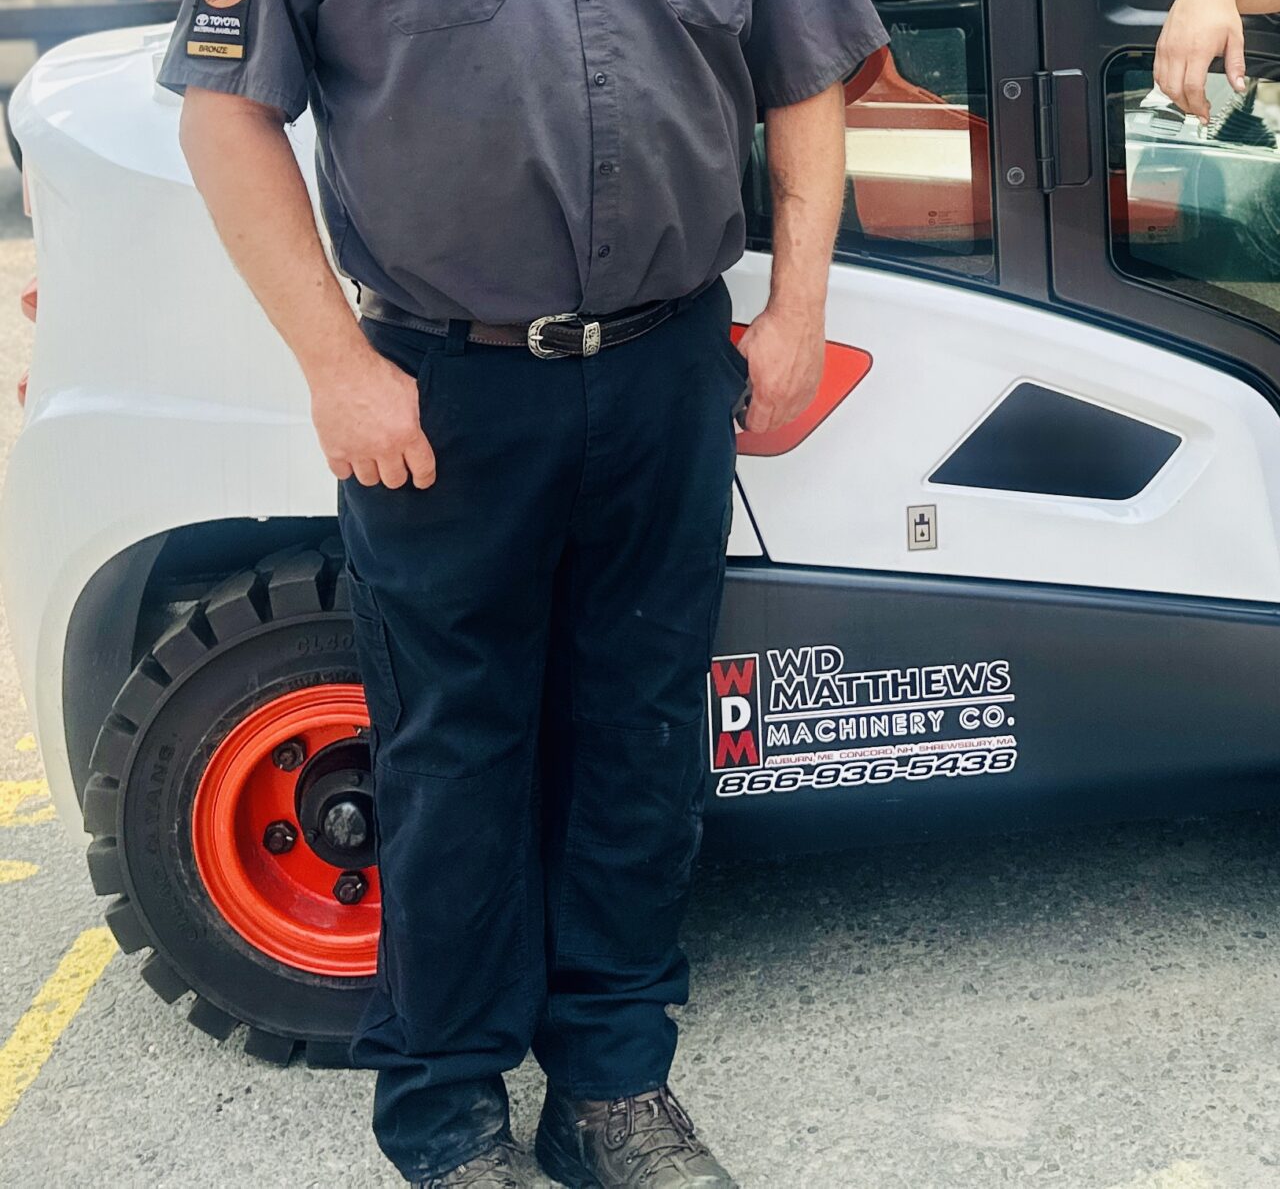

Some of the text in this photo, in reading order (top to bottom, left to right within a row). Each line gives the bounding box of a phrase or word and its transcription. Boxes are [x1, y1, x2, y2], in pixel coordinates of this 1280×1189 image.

[209, 15, 241, 28] TOYOTA
[198, 43, 228, 54] BRONZE
[766, 645, 844, 680] WD
[769, 660, 1012, 711] MATTHEWS
[766, 704, 1015, 748] MACHINERY CO.
[716, 750, 1018, 798] 866-936-5438
